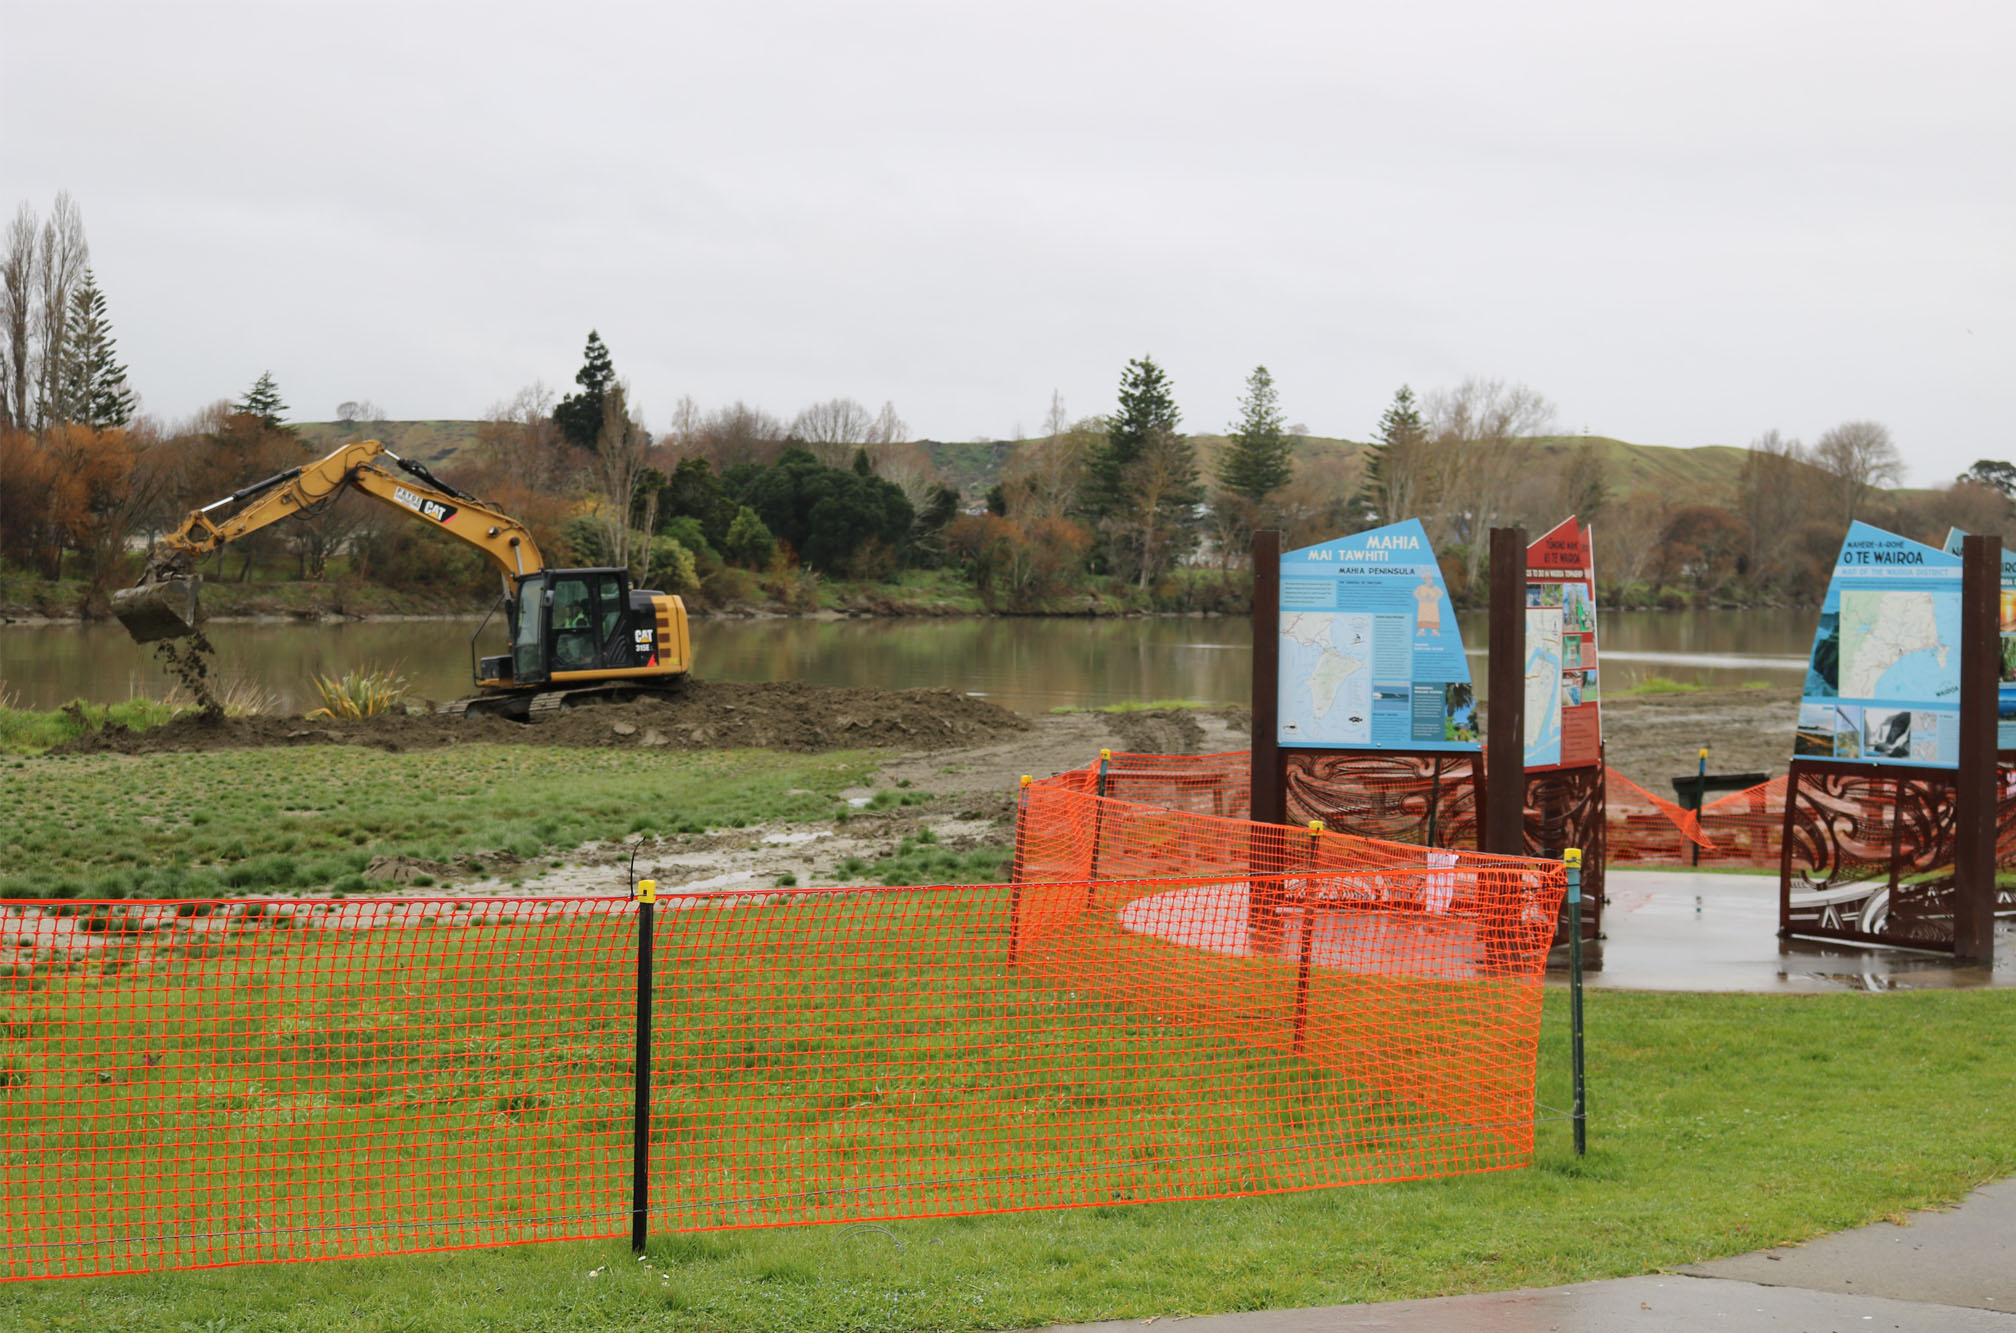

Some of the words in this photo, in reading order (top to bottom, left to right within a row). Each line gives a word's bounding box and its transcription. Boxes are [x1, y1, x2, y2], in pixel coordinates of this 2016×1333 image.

[424, 501, 446, 520] CAT
[1366, 535, 1419, 550] MAHIA
[1307, 549, 1333, 561] MAI
[1338, 550, 1389, 562] TAWHITI
[1844, 551, 1853, 564] O
[1856, 551, 1870, 564] TE
[1873, 551, 1924, 564] WAIROA
[1368, 567, 1416, 575] PENINSULA
[634, 629, 653, 643] CAT
